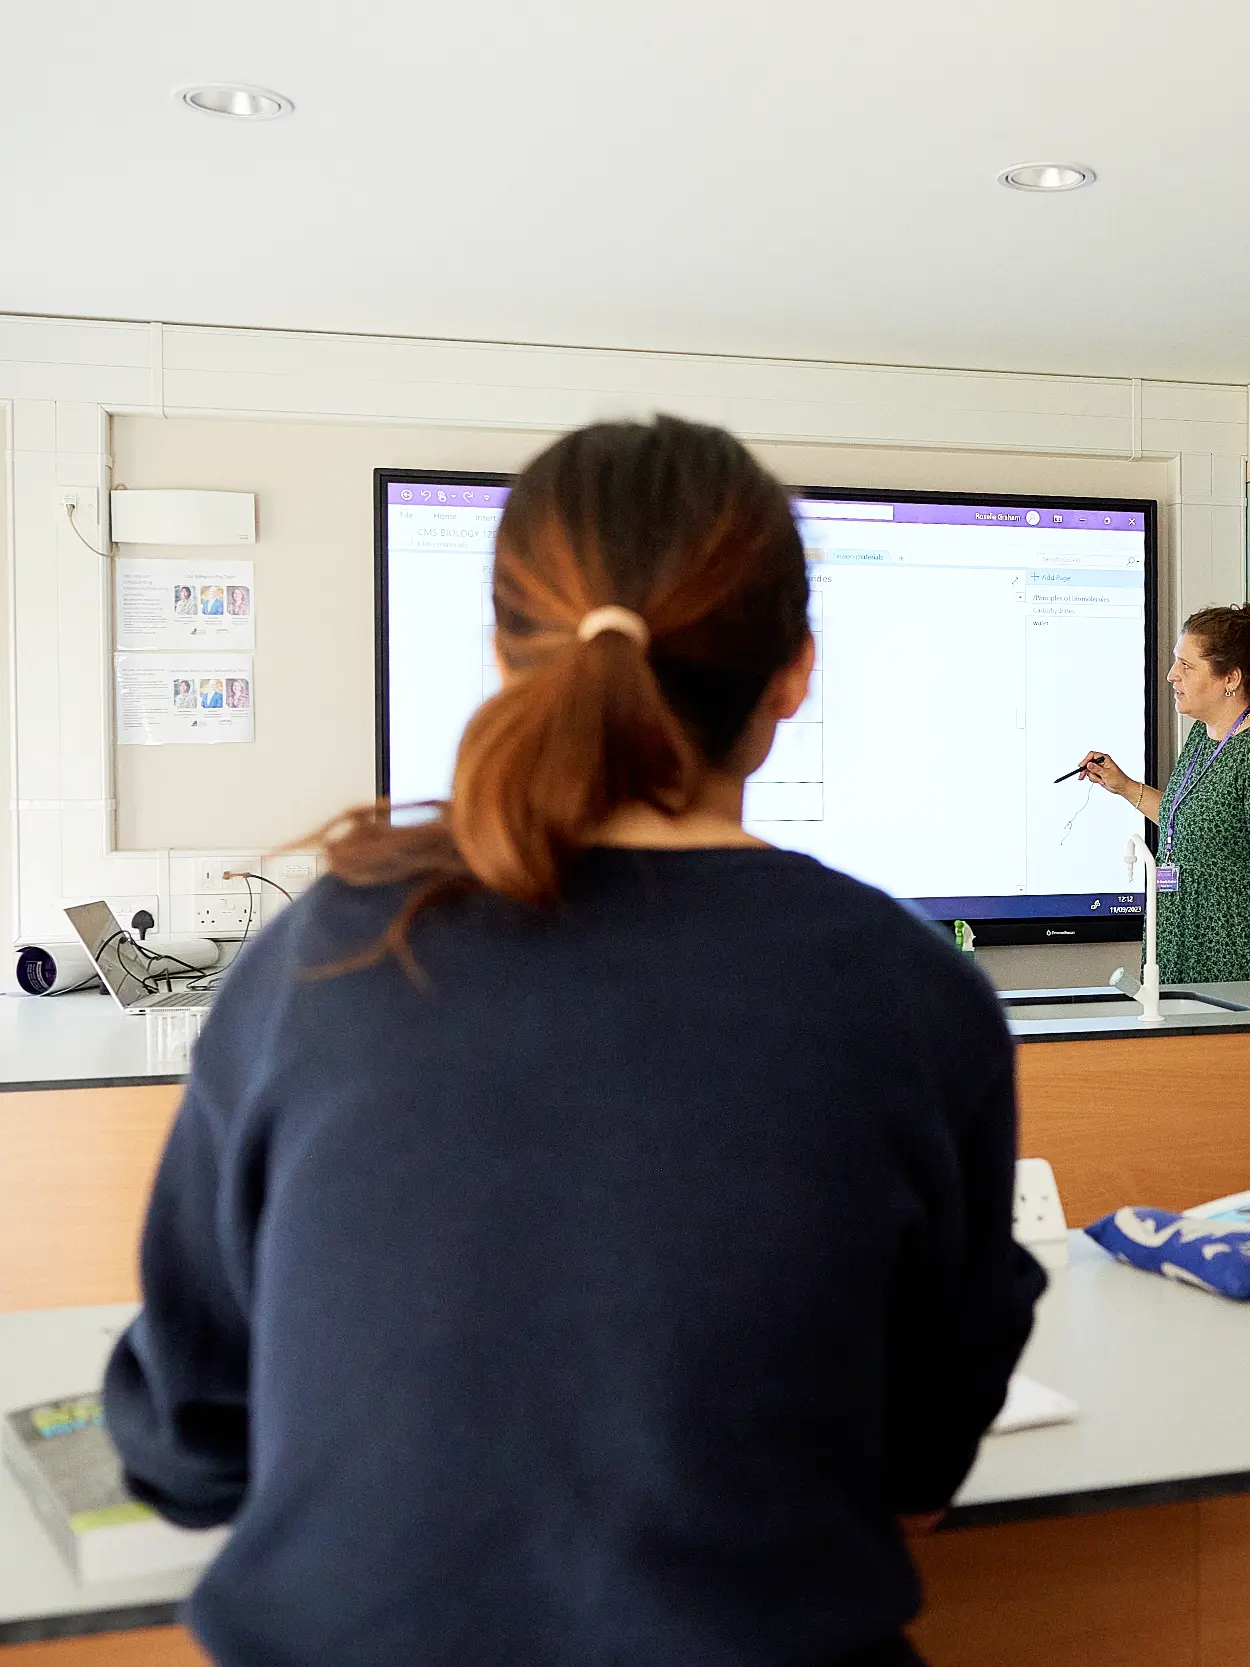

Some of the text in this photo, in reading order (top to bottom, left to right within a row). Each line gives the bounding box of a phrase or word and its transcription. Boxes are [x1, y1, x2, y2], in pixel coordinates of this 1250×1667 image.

[399, 511, 497, 522] File Home Insert
[417, 528, 438, 537] CMS
[440, 528, 480, 538] BIOLOGY
[855, 553, 884, 561] materials
[1041, 573, 1071, 583] Add Page
[1117, 895, 1134, 903] 12:12
